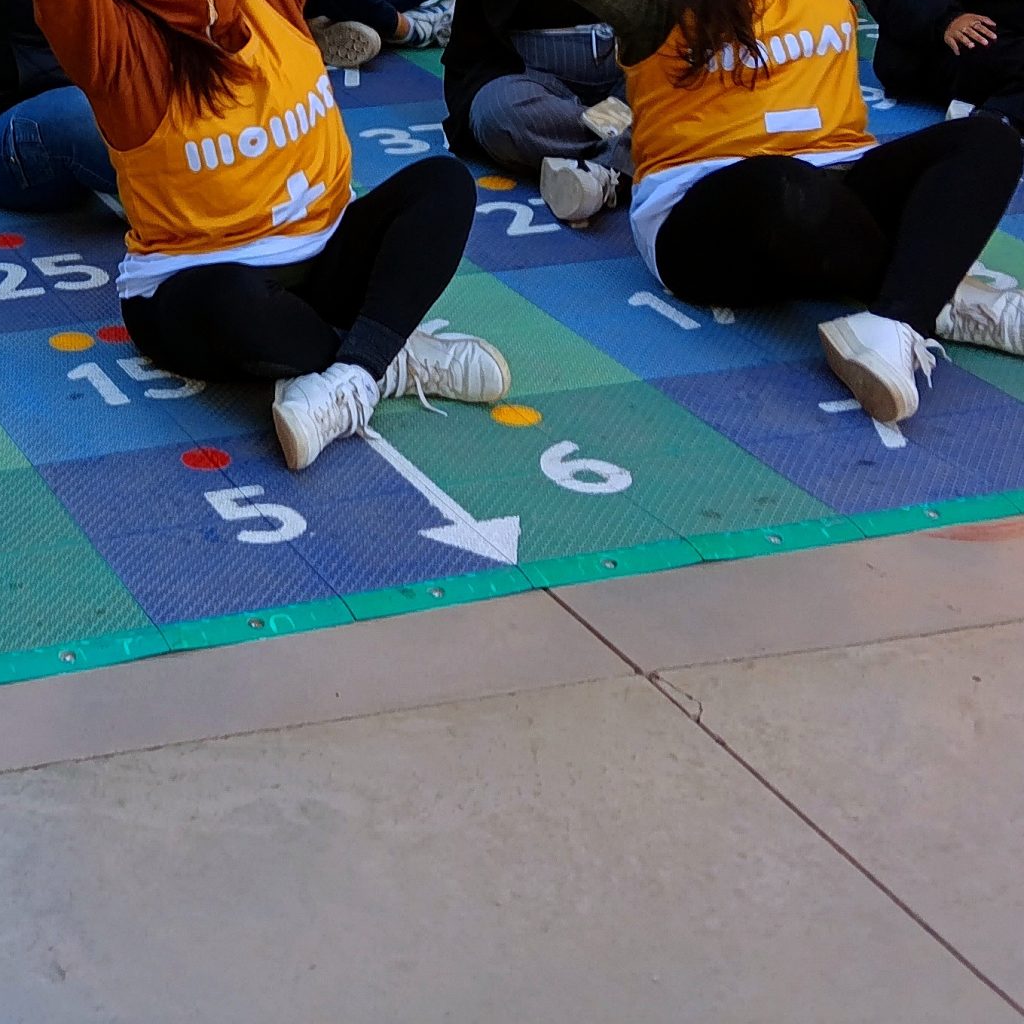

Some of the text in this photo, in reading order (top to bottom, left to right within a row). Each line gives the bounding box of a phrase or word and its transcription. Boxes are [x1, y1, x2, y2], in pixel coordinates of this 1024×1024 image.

[476, 198, 561, 235] 2
[66, 356, 206, 406] 15
[540, 440, 633, 494] 6
[203, 484, 308, 545] 5
